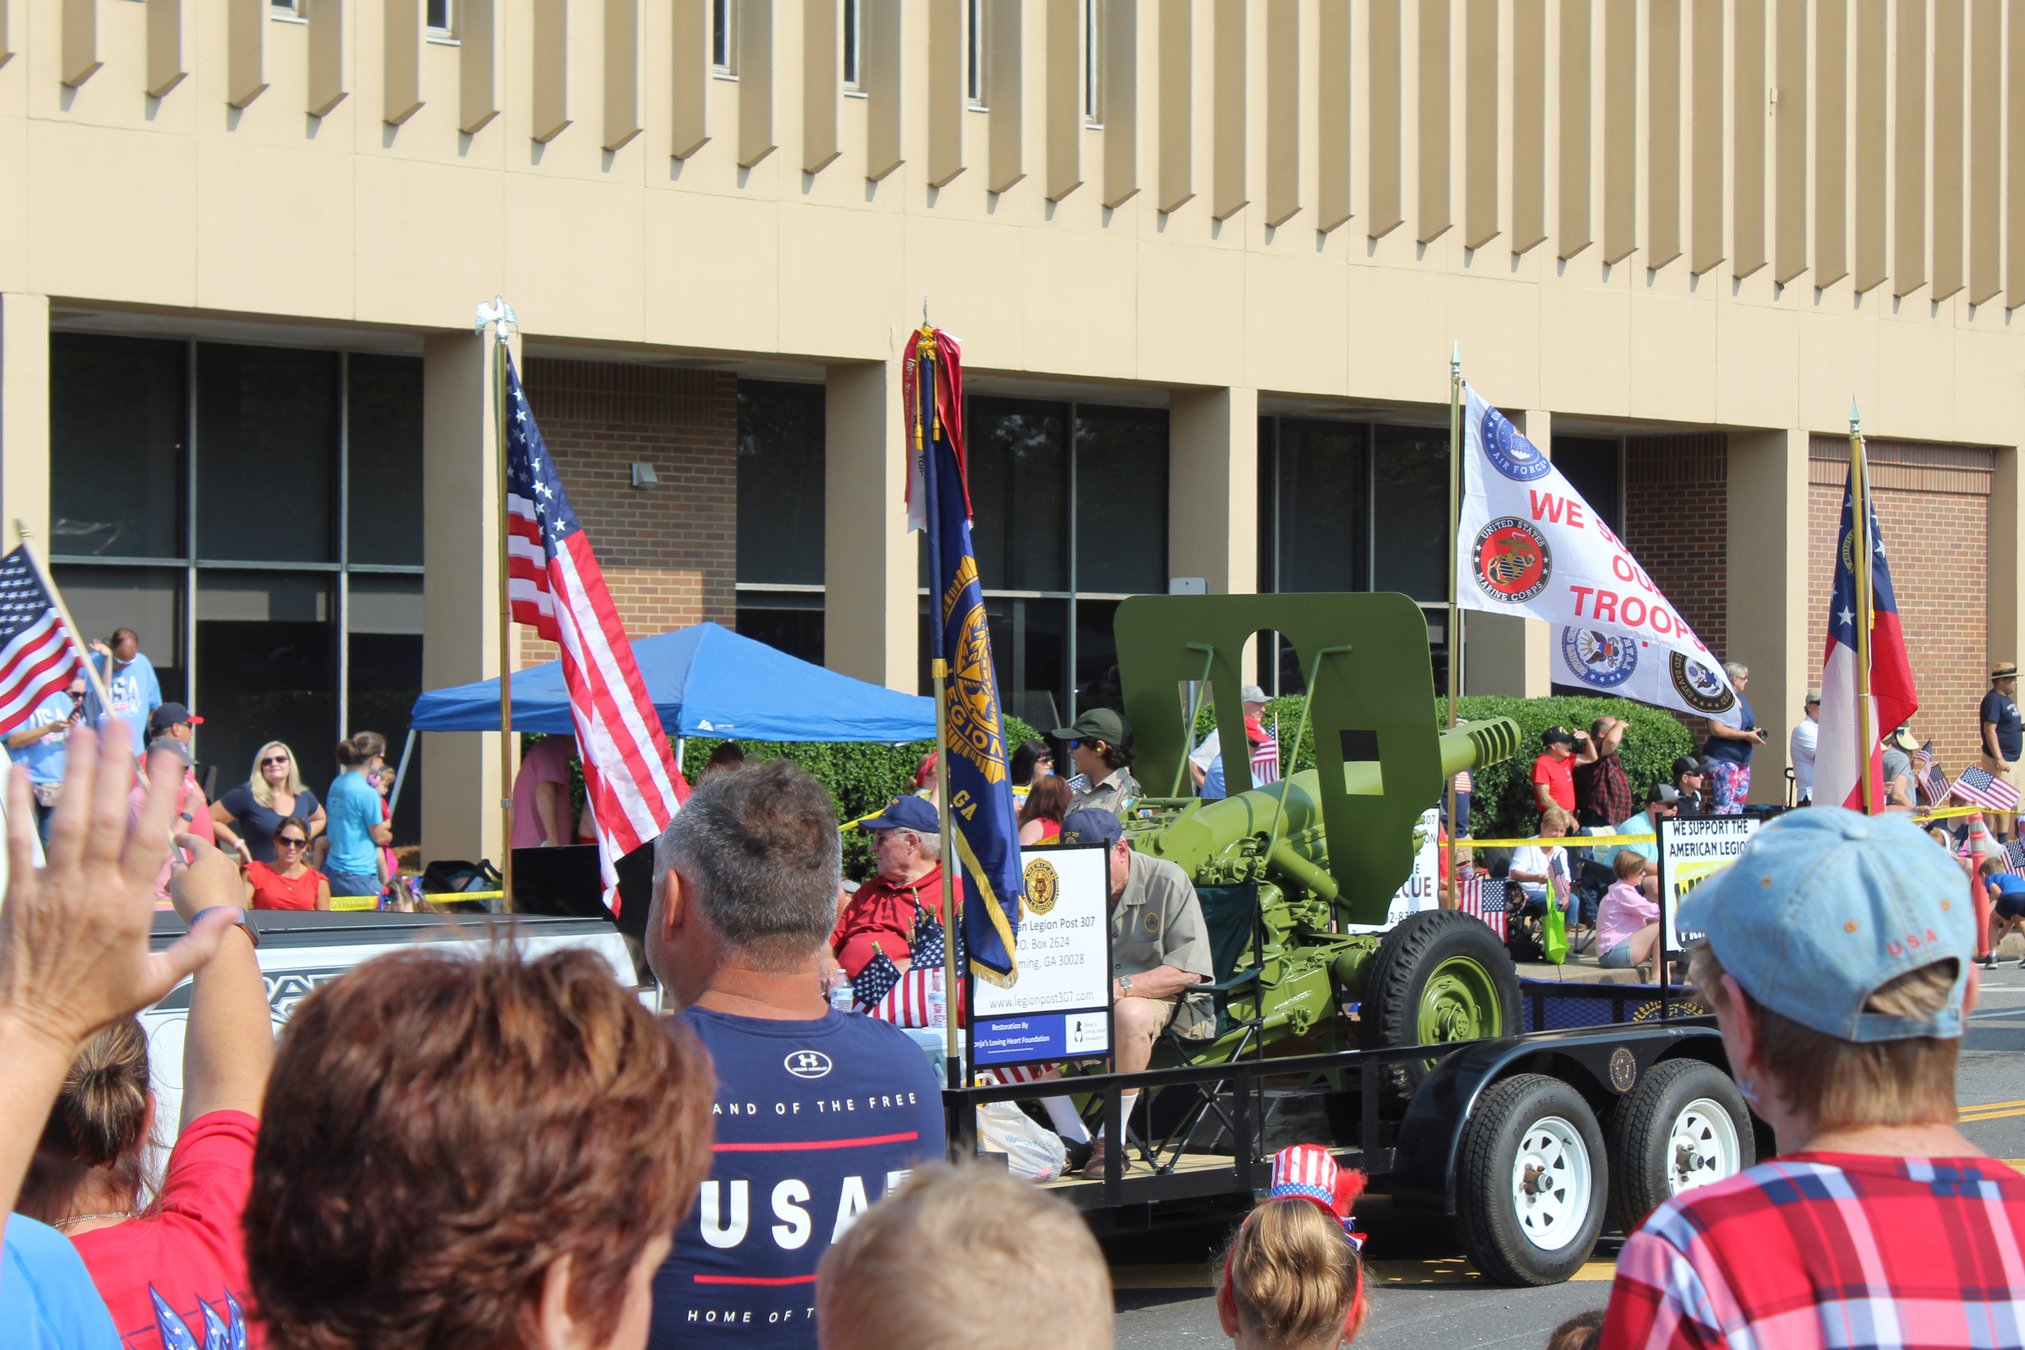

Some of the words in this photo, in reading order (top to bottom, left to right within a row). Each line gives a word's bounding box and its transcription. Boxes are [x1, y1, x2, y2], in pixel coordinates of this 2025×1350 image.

[1493, 451, 1510, 470] AIR
[1529, 489, 1585, 529] WE
[1481, 519, 1514, 539] UNITED
[1517, 520, 1545, 547] STATES
[1477, 572, 1508, 601] MARINE
[1510, 581, 1543, 601] CORPS
[1612, 554, 1669, 607] OU
[946, 685, 1004, 759] EGION
[952, 789, 978, 821] GA
[1673, 820, 1686, 836] WE
[1689, 820, 1729, 836] SUPPORT
[1730, 819, 1749, 835] THE
[1669, 842, 1717, 858] AMERICAN
[1720, 841, 1748, 857] LEGIO
[1029, 919, 1058, 933] Legion
[1060, 918, 1078, 929] Post
[1080, 916, 1095, 928] 307
[1017, 939, 1029, 951] .O.
[1031, 938, 1047, 950] Box
[1049, 936, 1070, 948] 2624
[1886, 928, 1938, 957] USA
[1017, 958, 1041, 970] ming,
[1044, 955, 1056, 967] GA
[1059, 953, 1085, 966] 30028
[989, 990, 1095, 1009] www.legionpost307.com
[991, 1022, 1021, 1031] Restoration
[1021, 1021, 1029, 1030] By
[989, 1038, 1006, 1047] Loving
[1006, 1037, 1021, 1045] Heart
[1021, 1035, 1050, 1044] Foundation
[712, 1102, 757, 1115] AND
[775, 1102, 801, 1115] OF
[817, 1099, 855, 1113] THE
[869, 1092, 917, 1110] FREE
[700, 1175, 870, 1250] USA
[687, 1309, 752, 1323] HOME
[768, 1309, 792, 1323] OF
